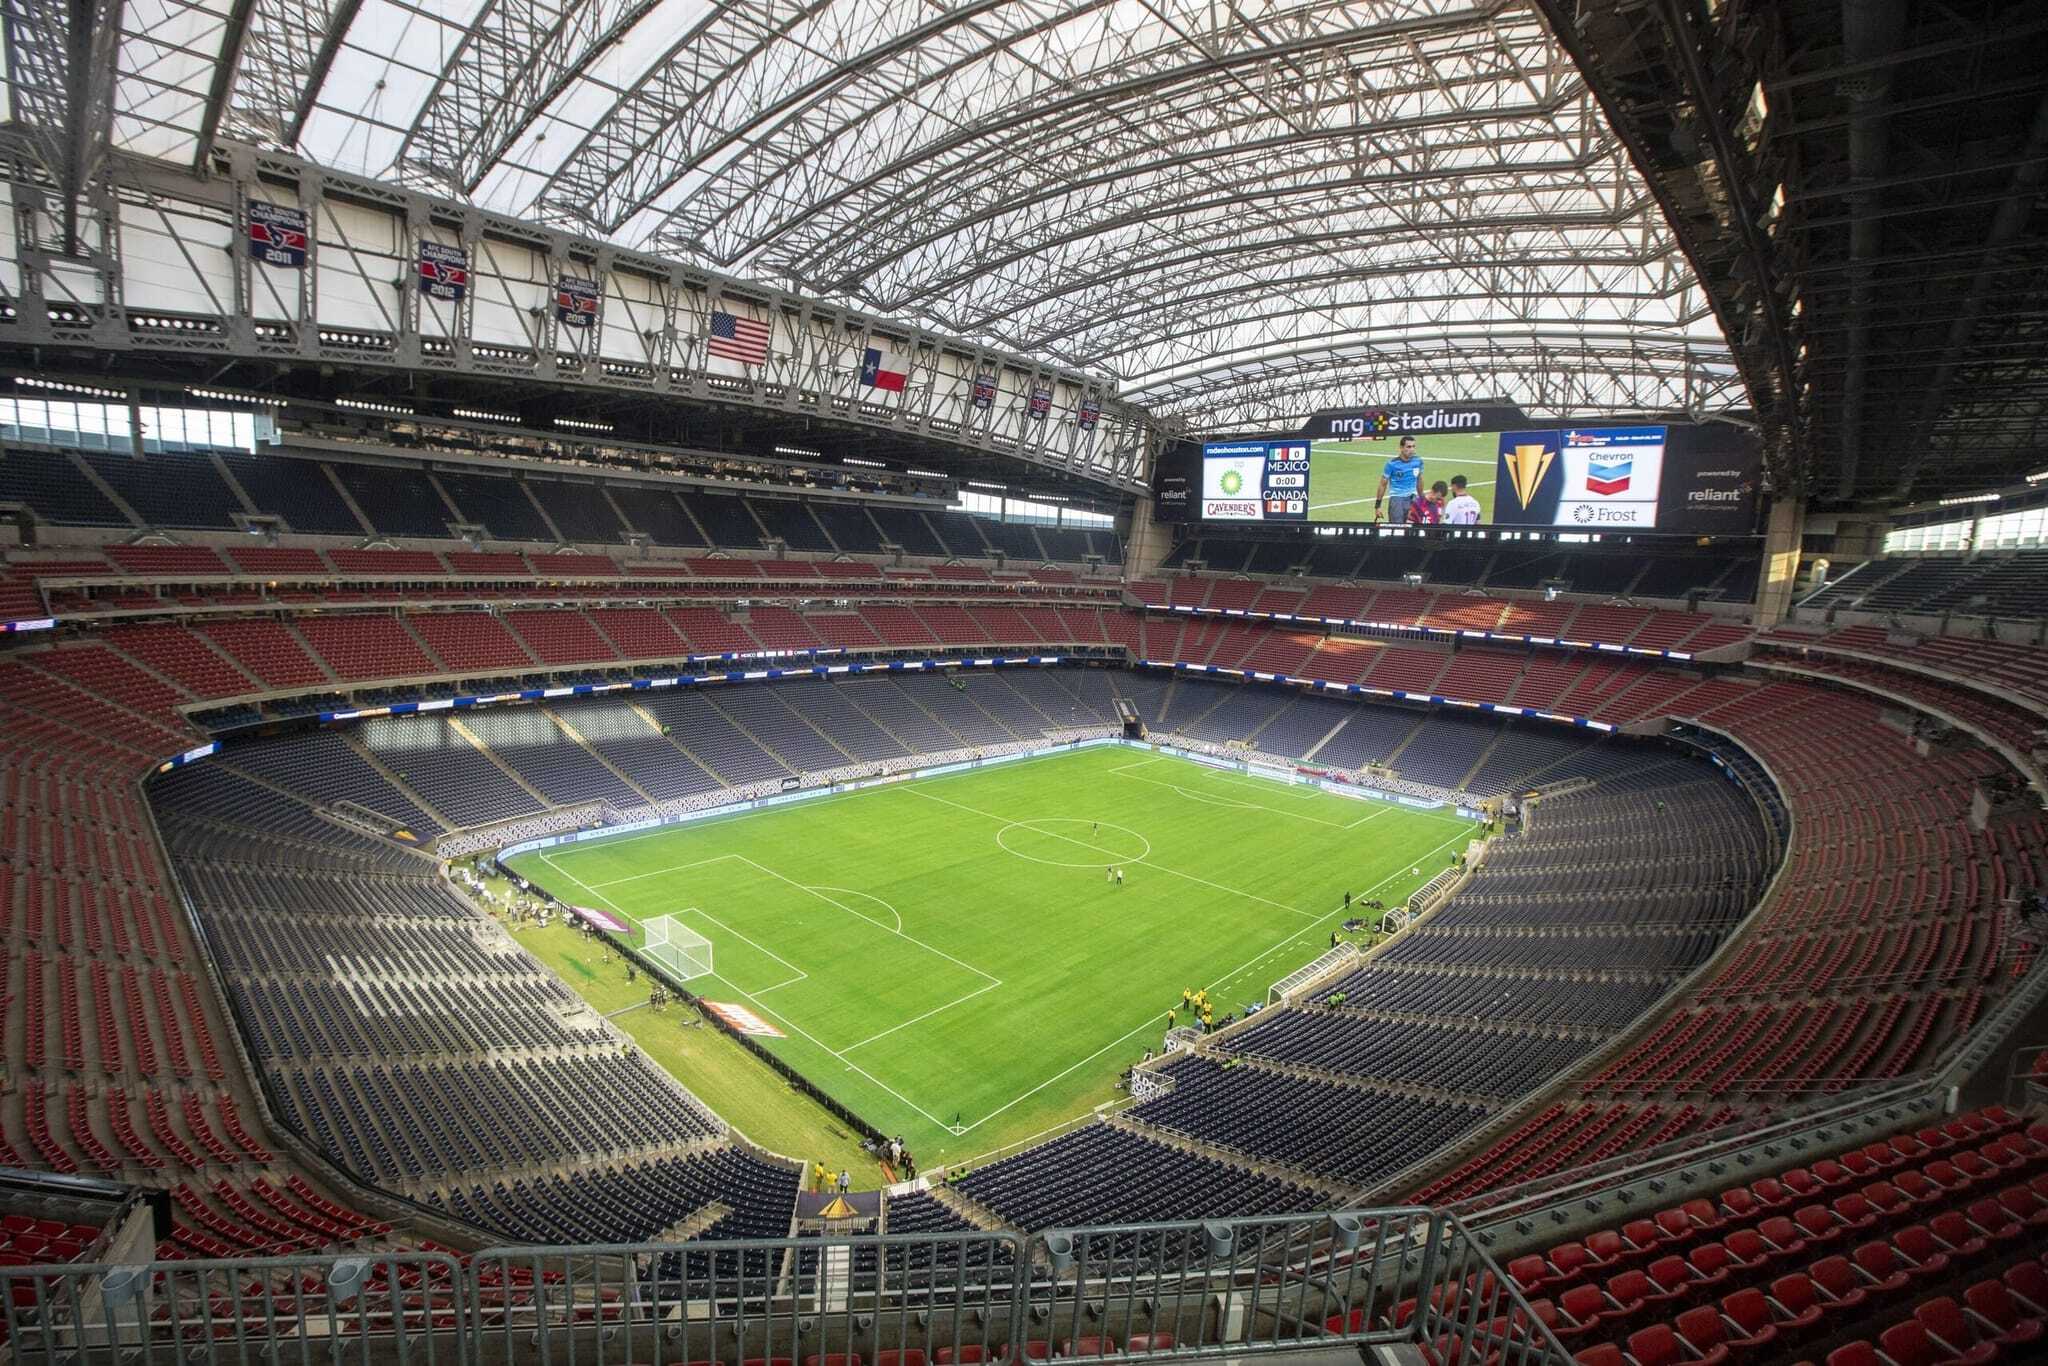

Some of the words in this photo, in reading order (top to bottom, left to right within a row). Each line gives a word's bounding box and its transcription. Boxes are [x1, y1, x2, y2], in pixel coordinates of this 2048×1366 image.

[250, 209, 305, 228] CHAMPIONS
[265, 248, 292, 264] 2011
[422, 249, 466, 265] CHAMPIONS
[430, 284, 455, 298] 2012
[1331, 418, 1364, 437] nrg
[1388, 409, 1481, 430] stadium
[1588, 451, 1634, 461] Chevron
[1267, 461, 1310, 472] MEXICO
[1697, 470, 1730, 478] powered
[1275, 477, 1297, 486] 0:00
[1161, 489, 1187, 499] reliant
[1263, 490, 1308, 501] CANADA
[1688, 488, 1742, 501] reliant
[1207, 502, 1257, 516] CAVENDER'S
[1597, 507, 1637, 522] Frost
